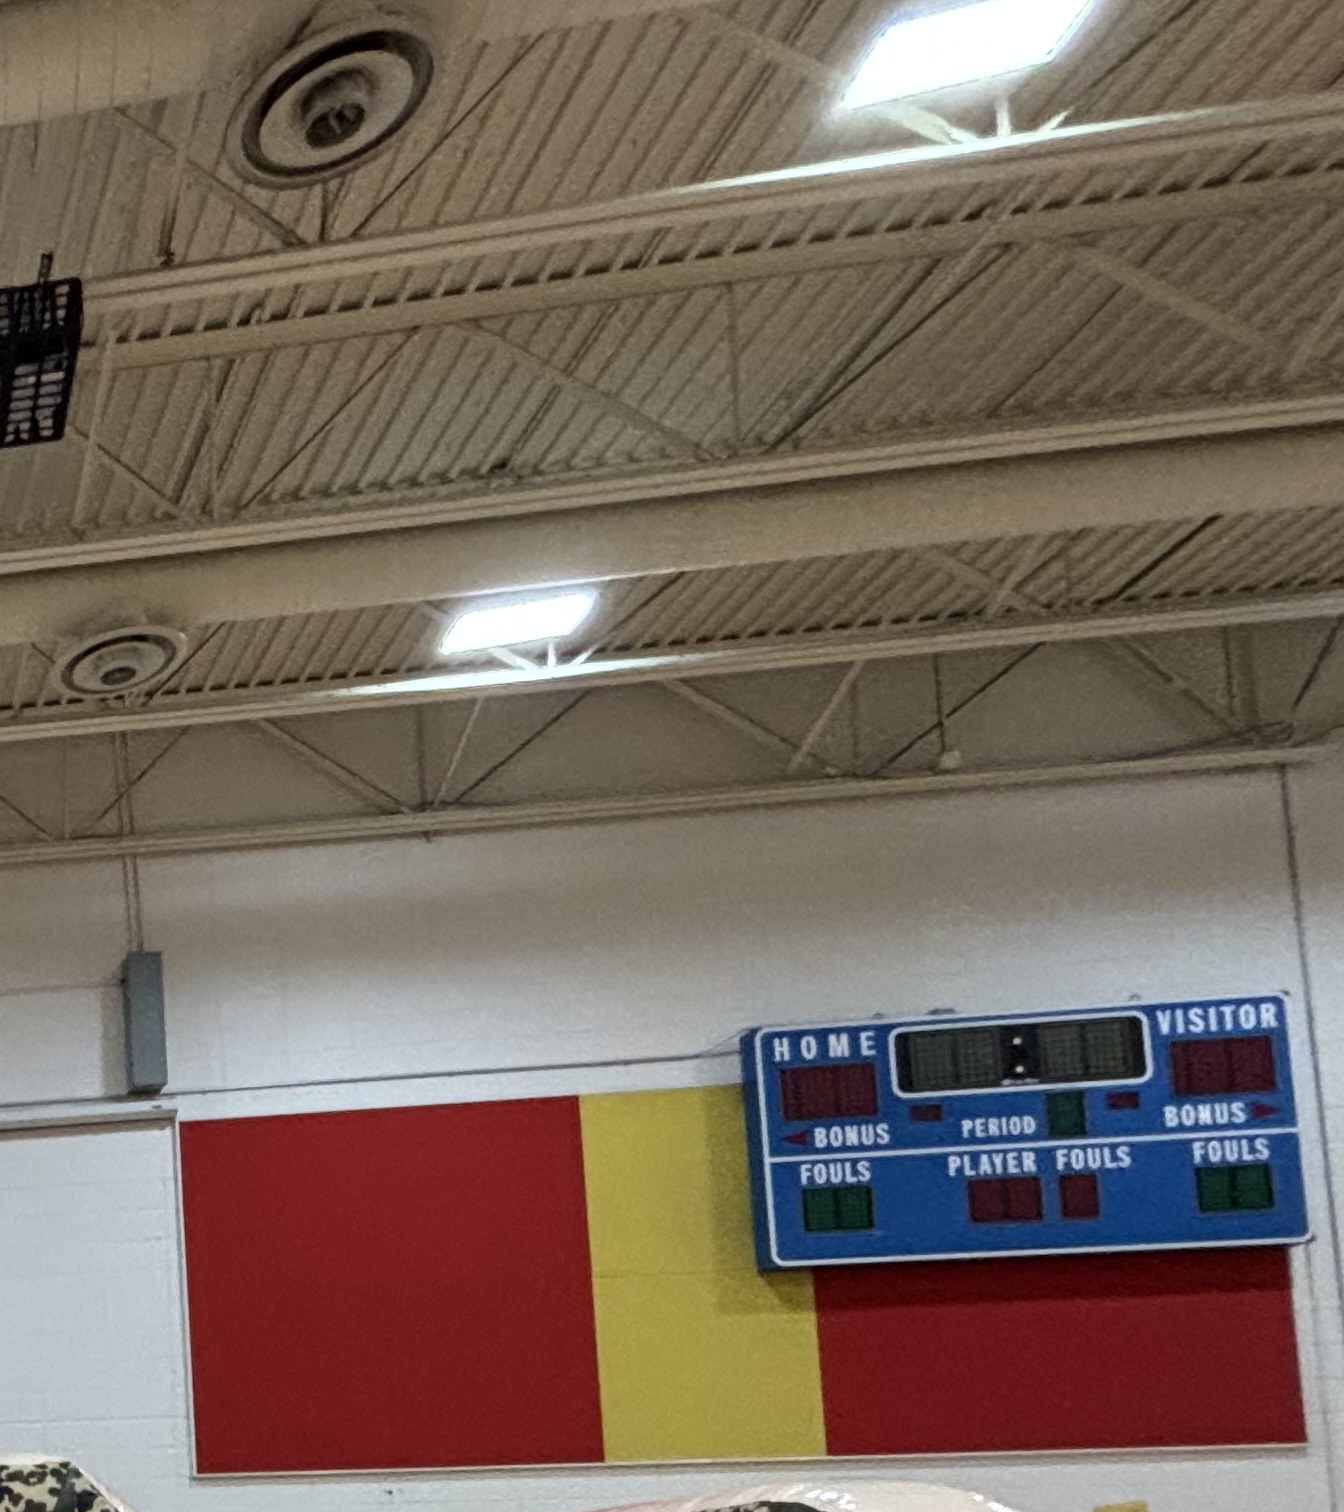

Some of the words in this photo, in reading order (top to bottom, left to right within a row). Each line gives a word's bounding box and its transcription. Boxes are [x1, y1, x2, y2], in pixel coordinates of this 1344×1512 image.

[1156, 1002, 1279, 1036] VISITOR
[772, 1031, 877, 1062] HOME
[961, 1115, 1036, 1139] PERIOD
[1163, 1103, 1247, 1127] BONUS
[813, 1124, 890, 1149] BONUS
[947, 1151, 1037, 1177] PLAYER
[1056, 1146, 1132, 1170] FOULS
[1192, 1138, 1270, 1164] FOULS
[799, 1161, 872, 1186] FOULS
